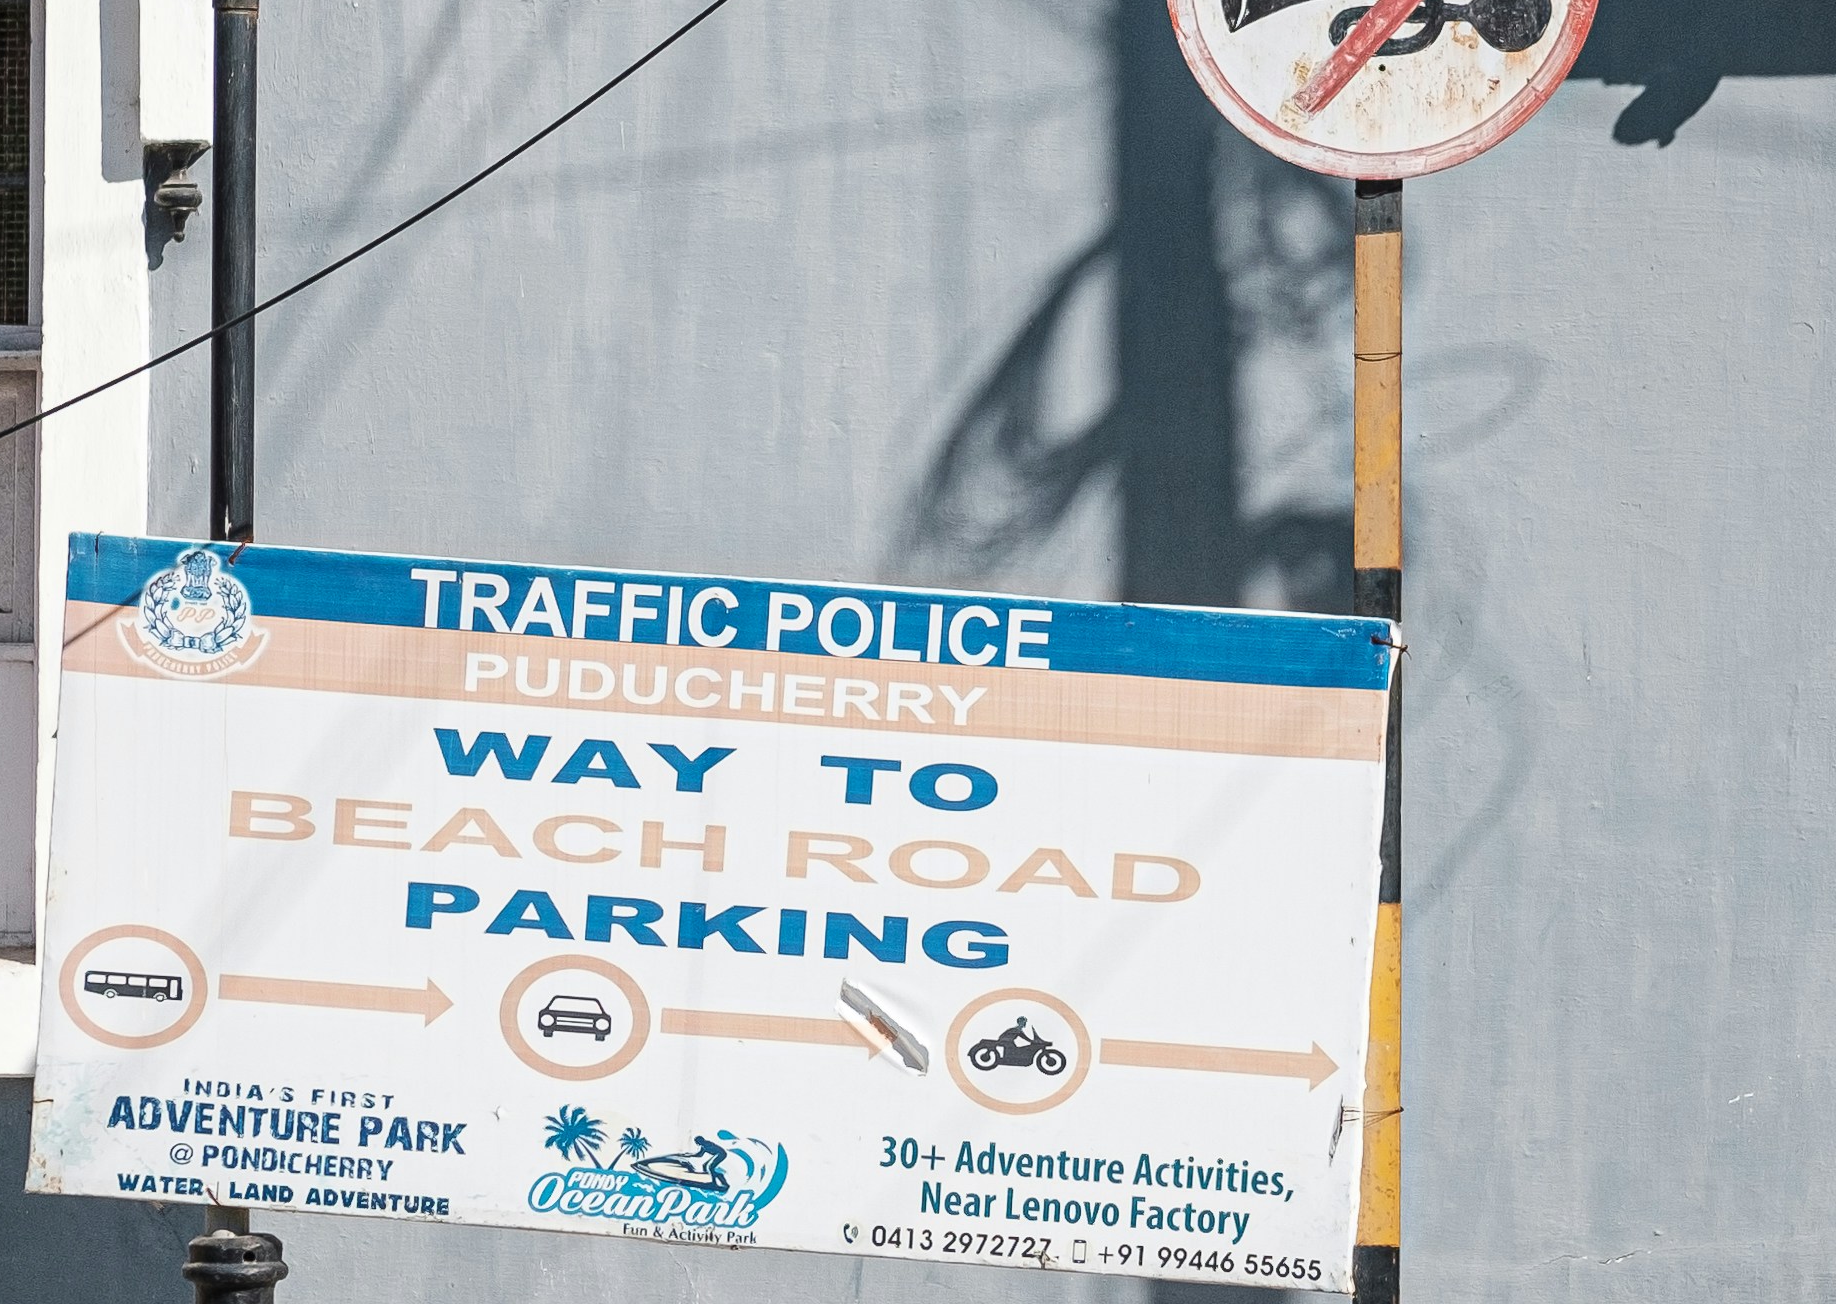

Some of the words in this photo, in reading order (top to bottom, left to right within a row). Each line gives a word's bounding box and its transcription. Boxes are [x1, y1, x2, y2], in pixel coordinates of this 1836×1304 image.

[409, 568, 740, 648] TRAFFIC
[765, 591, 1054, 671] POLICE
[464, 652, 989, 727] PUDUCHERRY
[432, 727, 737, 794] WAY
[820, 754, 1000, 812] TO
[227, 789, 728, 873] BEACH
[784, 830, 1202, 904] ROAD
[404, 880, 1010, 970] PARKING
[106, 1095, 341, 1146] ADVENTURE
[357, 1116, 468, 1156] PARK
[311, 1088, 395, 1111] FIRST
[169, 1143, 194, 1166] @
[201, 1144, 395, 1182] PONDICHERRY
[567, 1170, 630, 1193] PONDY
[878, 1136, 947, 1171] 30+
[954, 1140, 1125, 1185] Adventure
[1132, 1152, 1296, 1203] Activities,
[117, 1173, 205, 1197] WATER
[229, 1181, 295, 1204] LAND
[304, 1186, 450, 1217] ADVENTURE
[920, 1180, 997, 1218] Near
[1006, 1187, 1120, 1229] Lenovo
[1129, 1196, 1251, 1245] Factory
[622, 1222, 648, 1237] Fun
[667, 1227, 722, 1245] Activity
[726, 1230, 757, 1245] Park
[870, 1224, 934, 1252] 0413
[1097, 1243, 1146, 1268] +91
[1156, 1246, 1236, 1274] 99446
[1243, 1253, 1323, 1282] 55655
